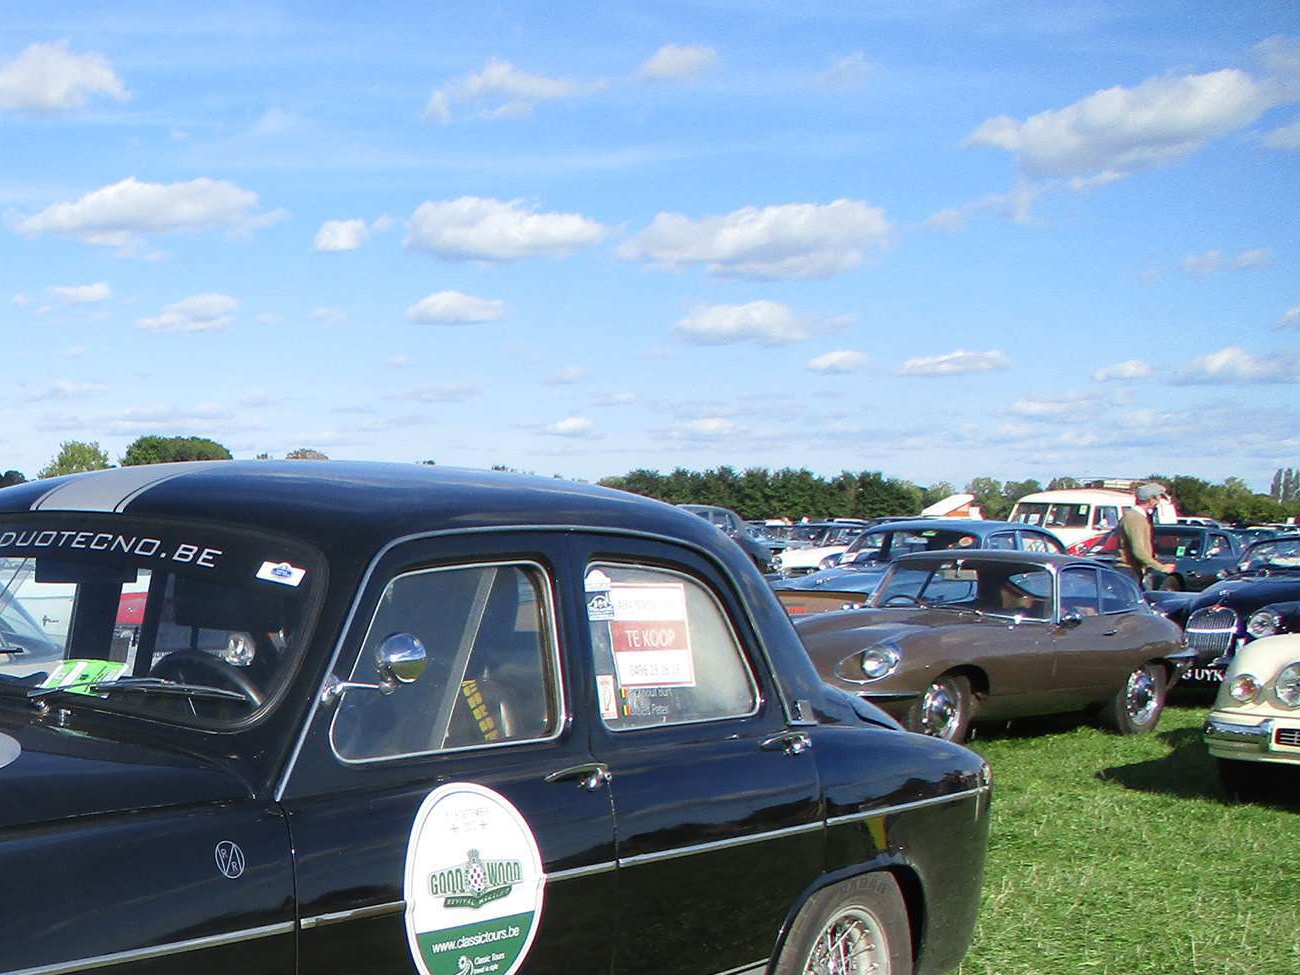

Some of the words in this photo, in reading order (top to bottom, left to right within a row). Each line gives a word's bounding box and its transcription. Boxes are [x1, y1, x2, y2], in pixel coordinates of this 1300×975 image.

[625, 630, 641, 647] TE
[642, 629, 676, 647] KOOP
[431, 868, 464, 895] GOOD
[486, 862, 520, 885] WOOD
[432, 925, 519, 953] www.classictours.be
